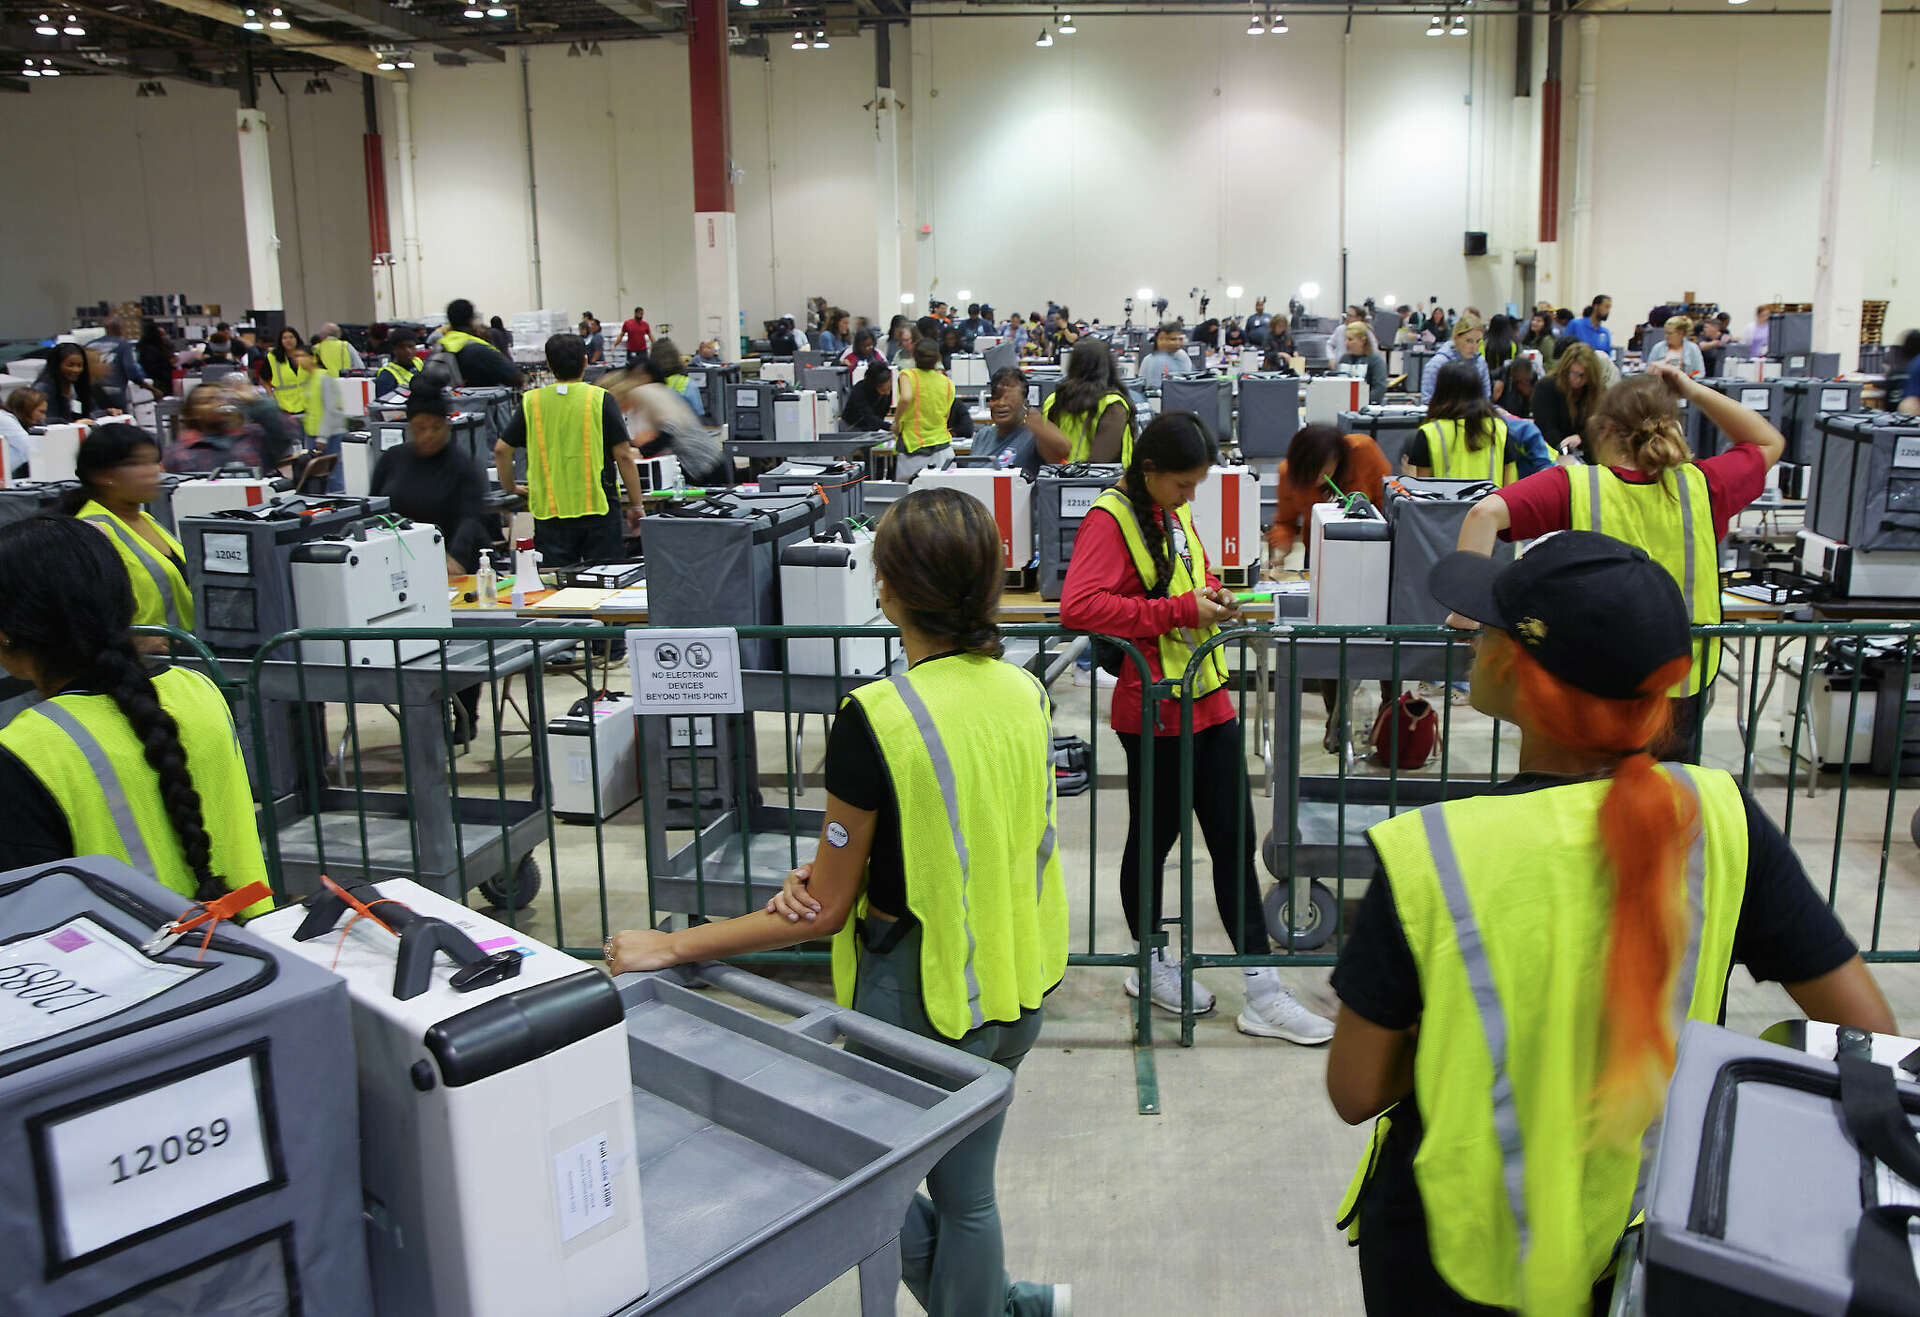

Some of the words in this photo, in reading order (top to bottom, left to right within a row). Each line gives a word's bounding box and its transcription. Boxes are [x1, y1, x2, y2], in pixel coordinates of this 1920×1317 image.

[1225, 536, 1237, 554] hi
[215, 550, 242, 561] 12042
[651, 671, 664, 679] NO
[666, 671, 719, 679] ELECTRONIC
[646, 693, 681, 701] BEYOND
[682, 692, 701, 700] THIS
[703, 692, 728, 700] POINT
[109, 1117, 231, 1185] 12089
